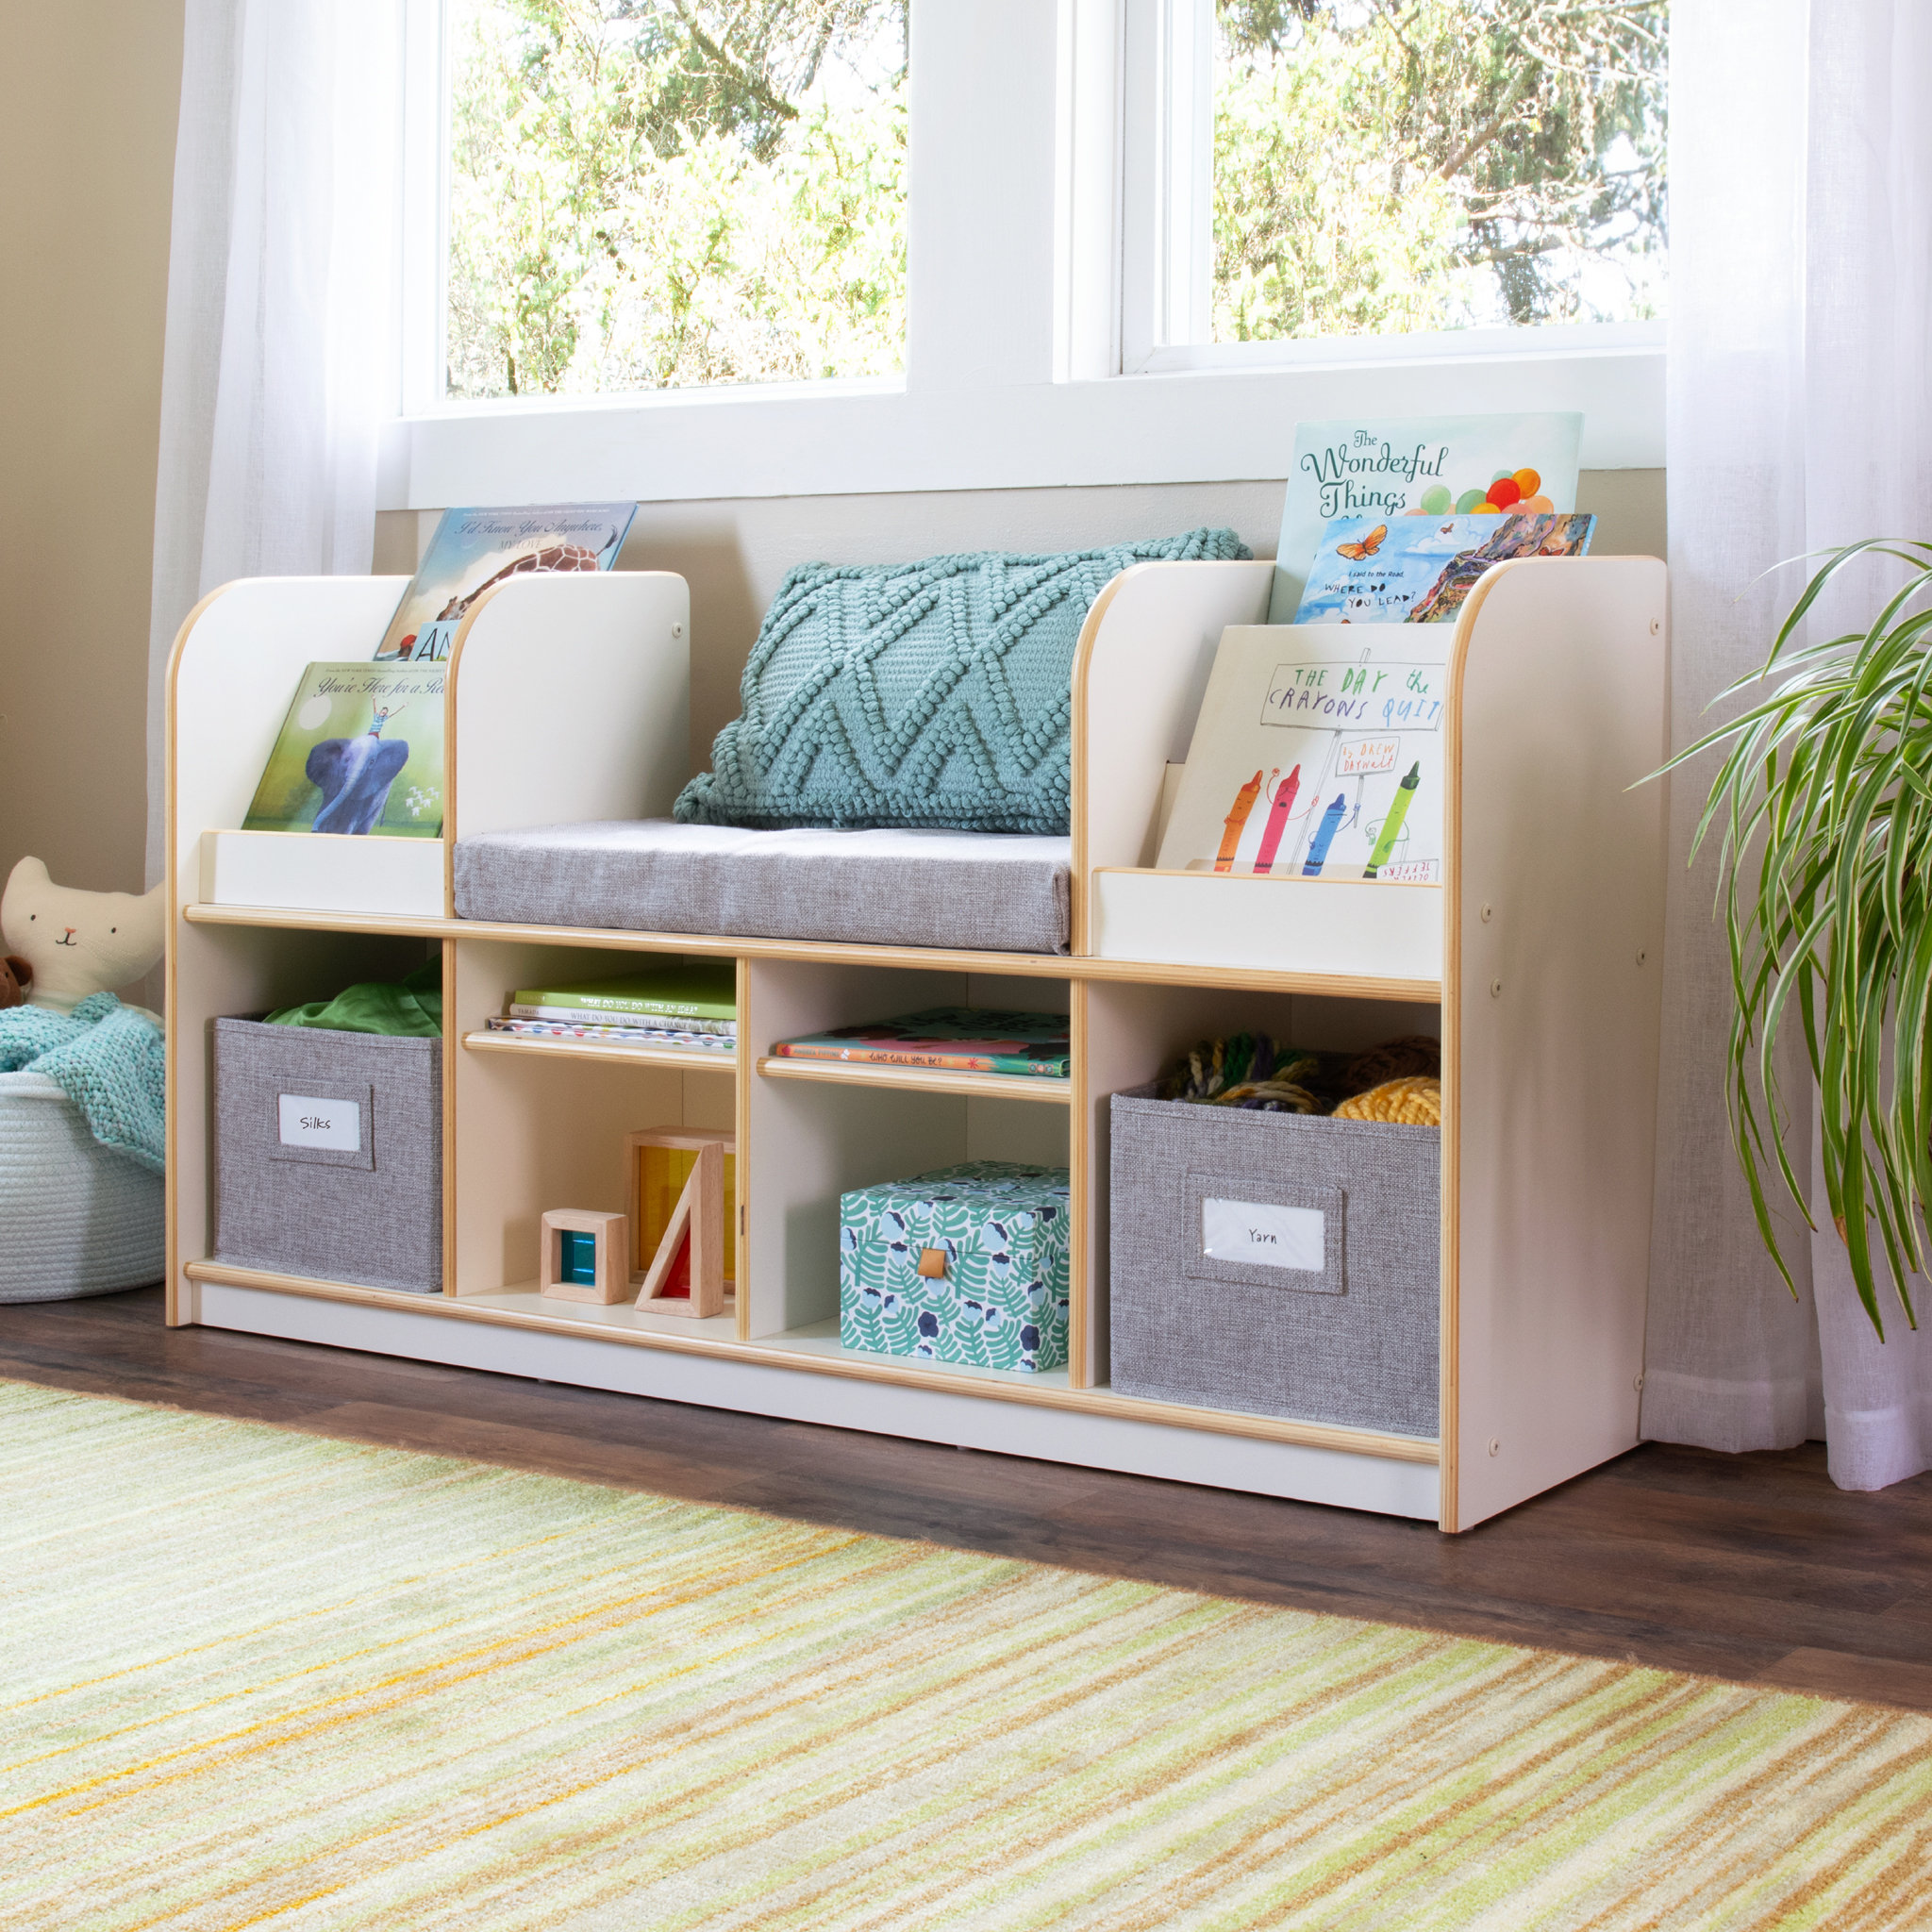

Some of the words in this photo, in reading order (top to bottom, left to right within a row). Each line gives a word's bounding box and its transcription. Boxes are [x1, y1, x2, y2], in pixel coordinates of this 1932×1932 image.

[1354, 430, 1377, 448] The
[1301, 442, 1449, 483] Wonderful
[1320, 479, 1406, 518] Things
[478, 520, 513, 535] Know
[514, 520, 543, 537] You
[1324, 583, 1364, 595] WHERE
[1371, 583, 1386, 592] DO
[1349, 597, 1371, 608] YOU
[1378, 591, 1416, 607] LEAD?
[312, 676, 358, 697] You're
[357, 677, 391, 693] Here
[382, 677, 409, 697] for
[409, 683, 421, 694] a
[1295, 669, 1328, 687] THE
[1341, 668, 1389, 695] DAY
[1407, 669, 1429, 693] the
[1270, 688, 1368, 720] CRAYONS
[1383, 698, 1441, 727] QUIT
[580, 997, 602, 1008] WHAT
[603, 999, 614, 1008] DO
[631, 1001, 643, 1010] DO
[570, 1012, 591, 1021] WHAT
[591, 1014, 603, 1023] DO
[604, 1015, 619, 1024] YOU
[619, 1016, 631, 1024] DO
[632, 1017, 651, 1026] WITH
[300, 1117, 331, 1129] Silks
[1249, 1228, 1277, 1244] Yarn
